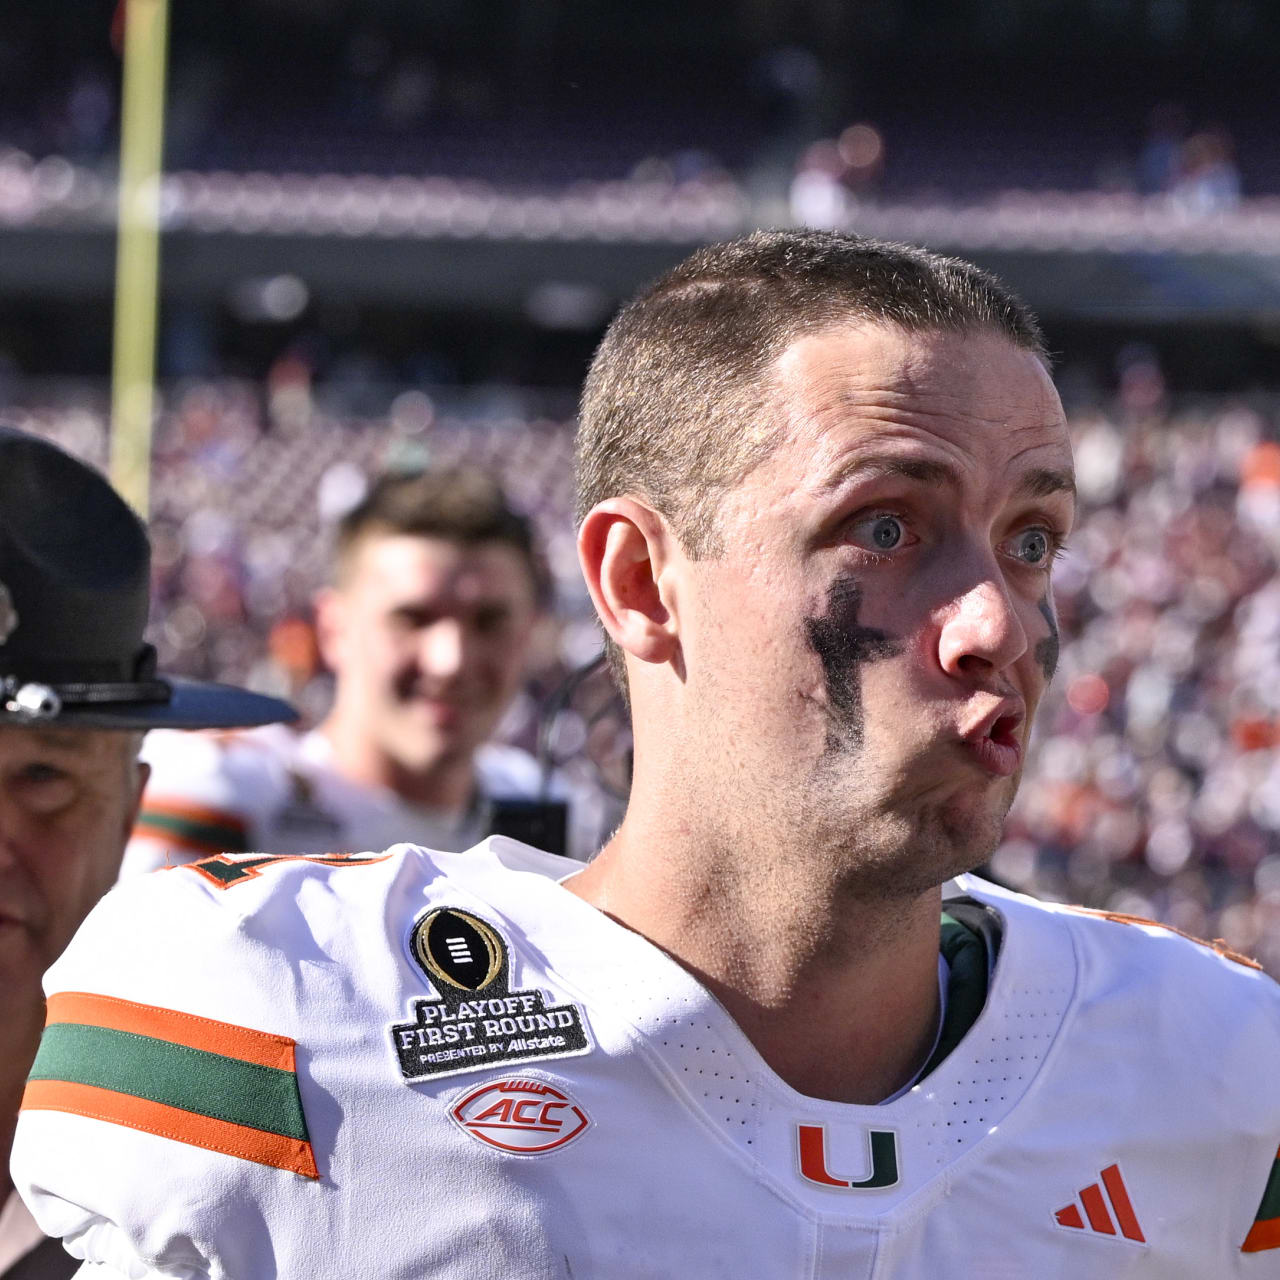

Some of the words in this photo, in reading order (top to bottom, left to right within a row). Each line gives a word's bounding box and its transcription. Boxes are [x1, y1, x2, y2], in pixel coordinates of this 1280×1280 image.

[422, 995, 537, 1024] PLAYOFF
[399, 1022, 476, 1050] FIRST
[483, 1010, 574, 1037] ROUND
[420, 1045, 486, 1064] PRESENTED
[489, 1042, 504, 1053] BY
[507, 1035, 566, 1053] Allstate
[473, 1098, 570, 1126] ACC
[795, 1122, 901, 1189] U
